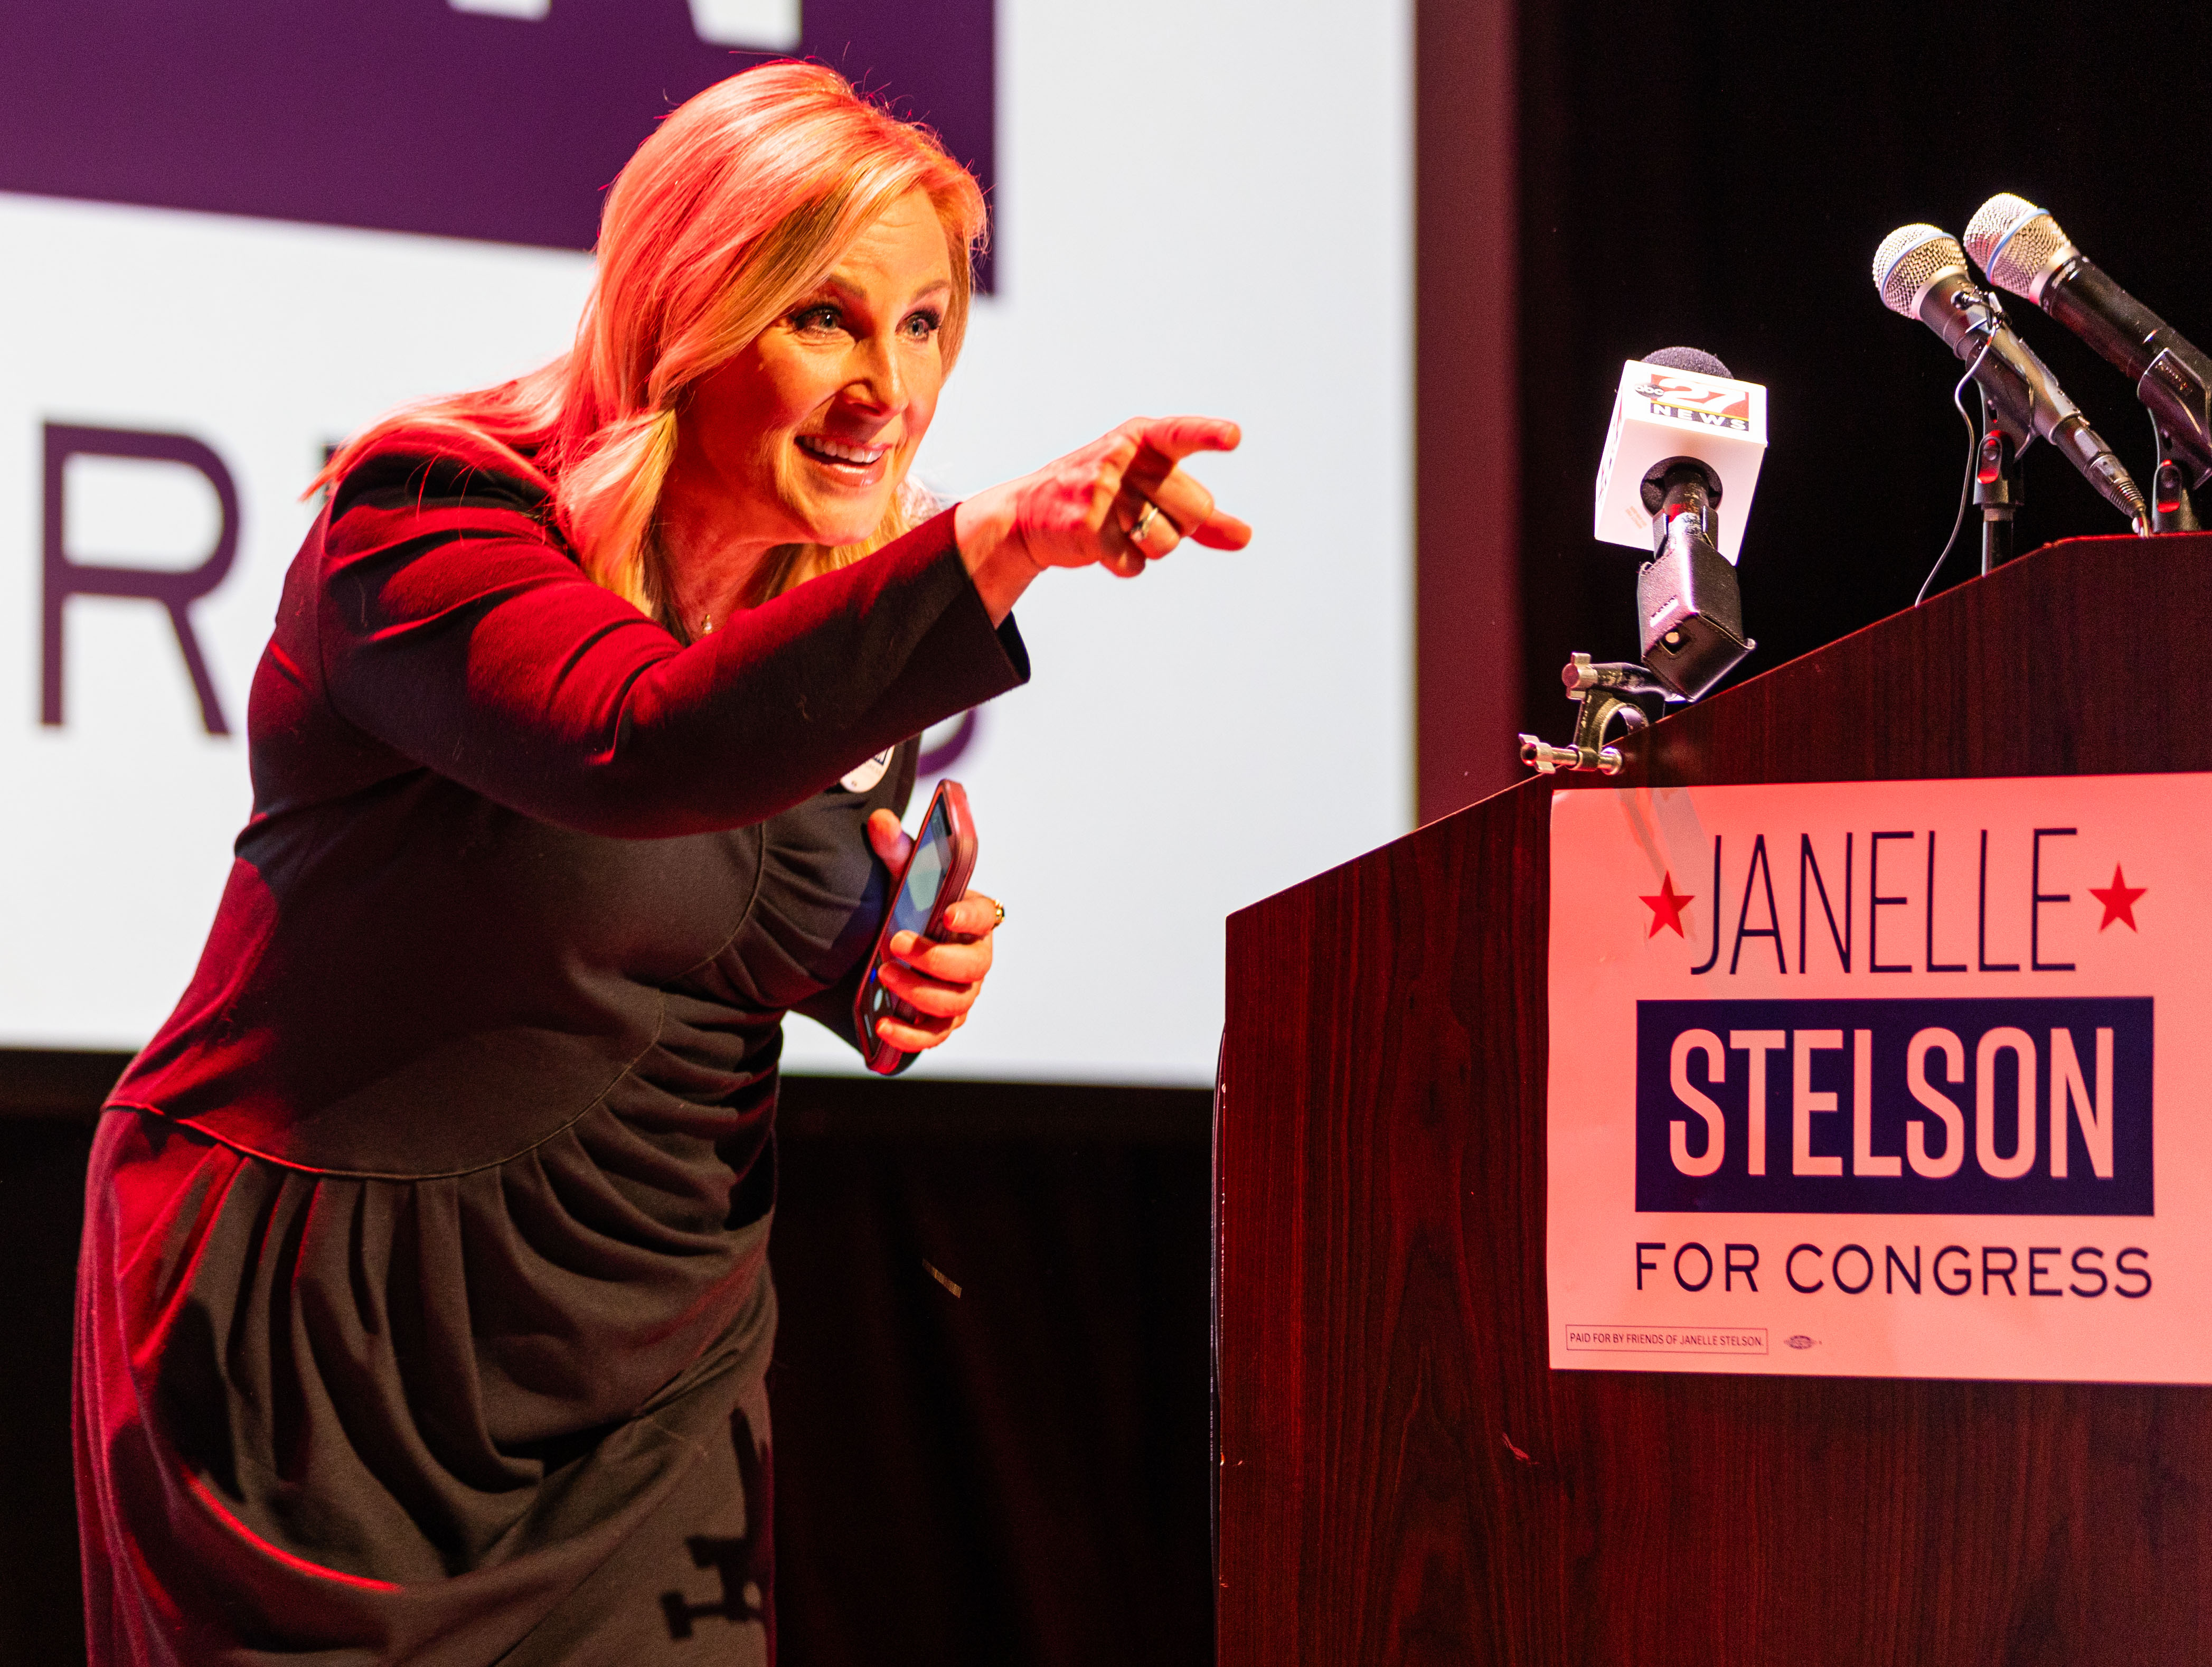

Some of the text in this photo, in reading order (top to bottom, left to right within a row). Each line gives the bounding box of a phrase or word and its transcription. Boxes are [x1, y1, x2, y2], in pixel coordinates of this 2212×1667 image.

[1635, 384, 1664, 397] abc
[1657, 377, 1746, 414] 27
[1653, 404, 1746, 430] NEWS
[1691, 828, 2077, 975] JANELLE
[1669, 1026, 2114, 1179] STELSON
[1635, 1242, 2153, 1299] FOR CONGRESS
[1570, 1333, 1764, 1346] PAID FOR BY FRIENDS OF JANELLE STELSON.
